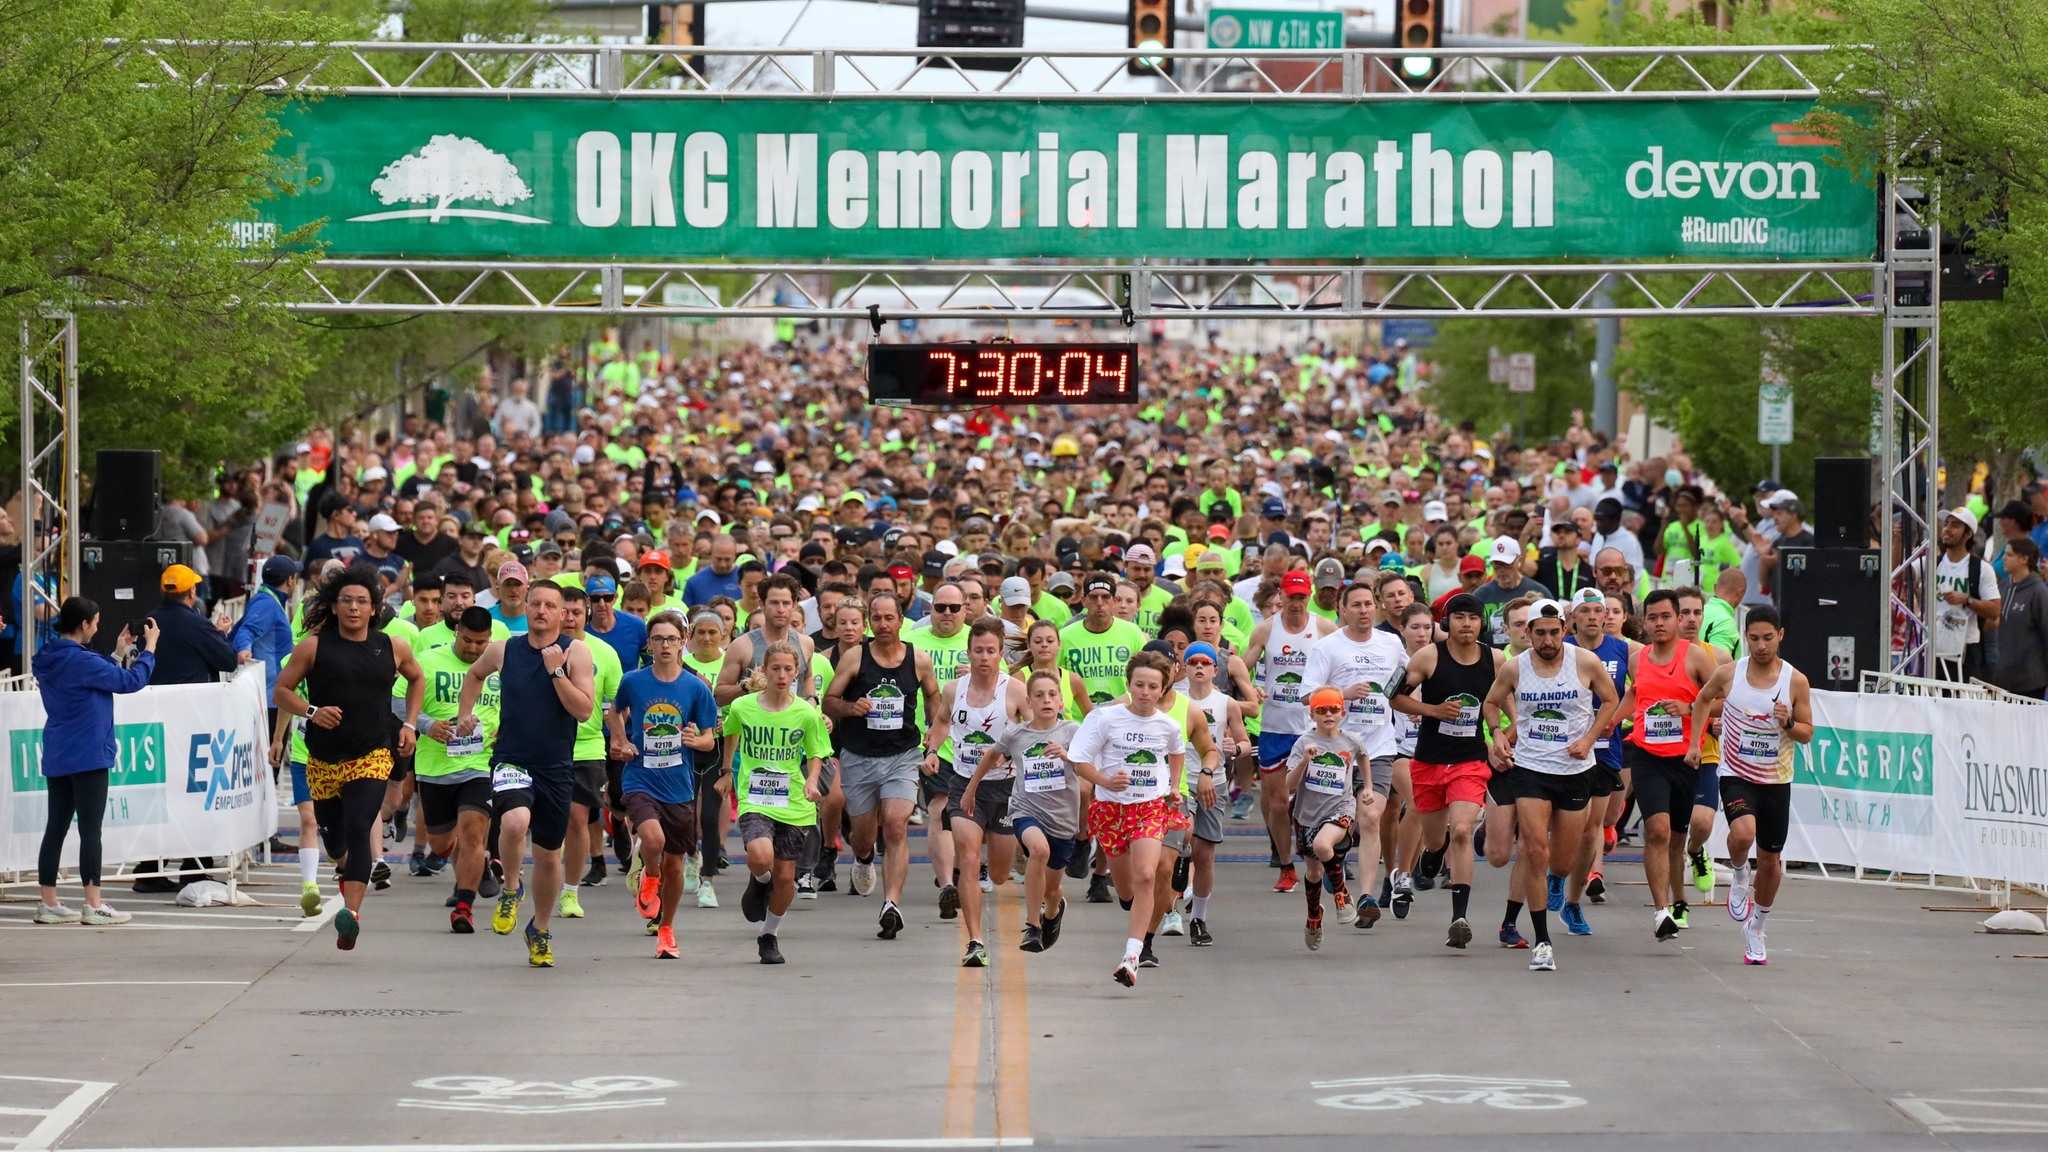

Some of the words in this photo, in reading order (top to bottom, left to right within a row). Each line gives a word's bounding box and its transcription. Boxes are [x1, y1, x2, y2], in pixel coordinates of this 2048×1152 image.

[1248, 19, 1273, 46] NW
[1278, 19, 1311, 48] 6TH
[1315, 20, 1336, 48] ST
[576, 130, 728, 228] OKC
[756, 131, 1138, 229] Memorial
[1166, 132, 1554, 229] Marathon
[1625, 145, 1820, 200] devon
[1681, 216, 1769, 244] #RunOKC
[929, 352, 1127, 396] 7:30:04
[1520, 689, 1579, 702] OKLAHOMA
[1537, 702, 1562, 710] CITY
[742, 723, 774, 758] RUN
[1126, 732, 1144, 743] CFS
[1537, 724, 1560, 733] 42939
[1750, 741, 1770, 749] 41795
[1802, 739, 1924, 782] NTEGRIS
[1821, 797, 1891, 826] HEALTH
